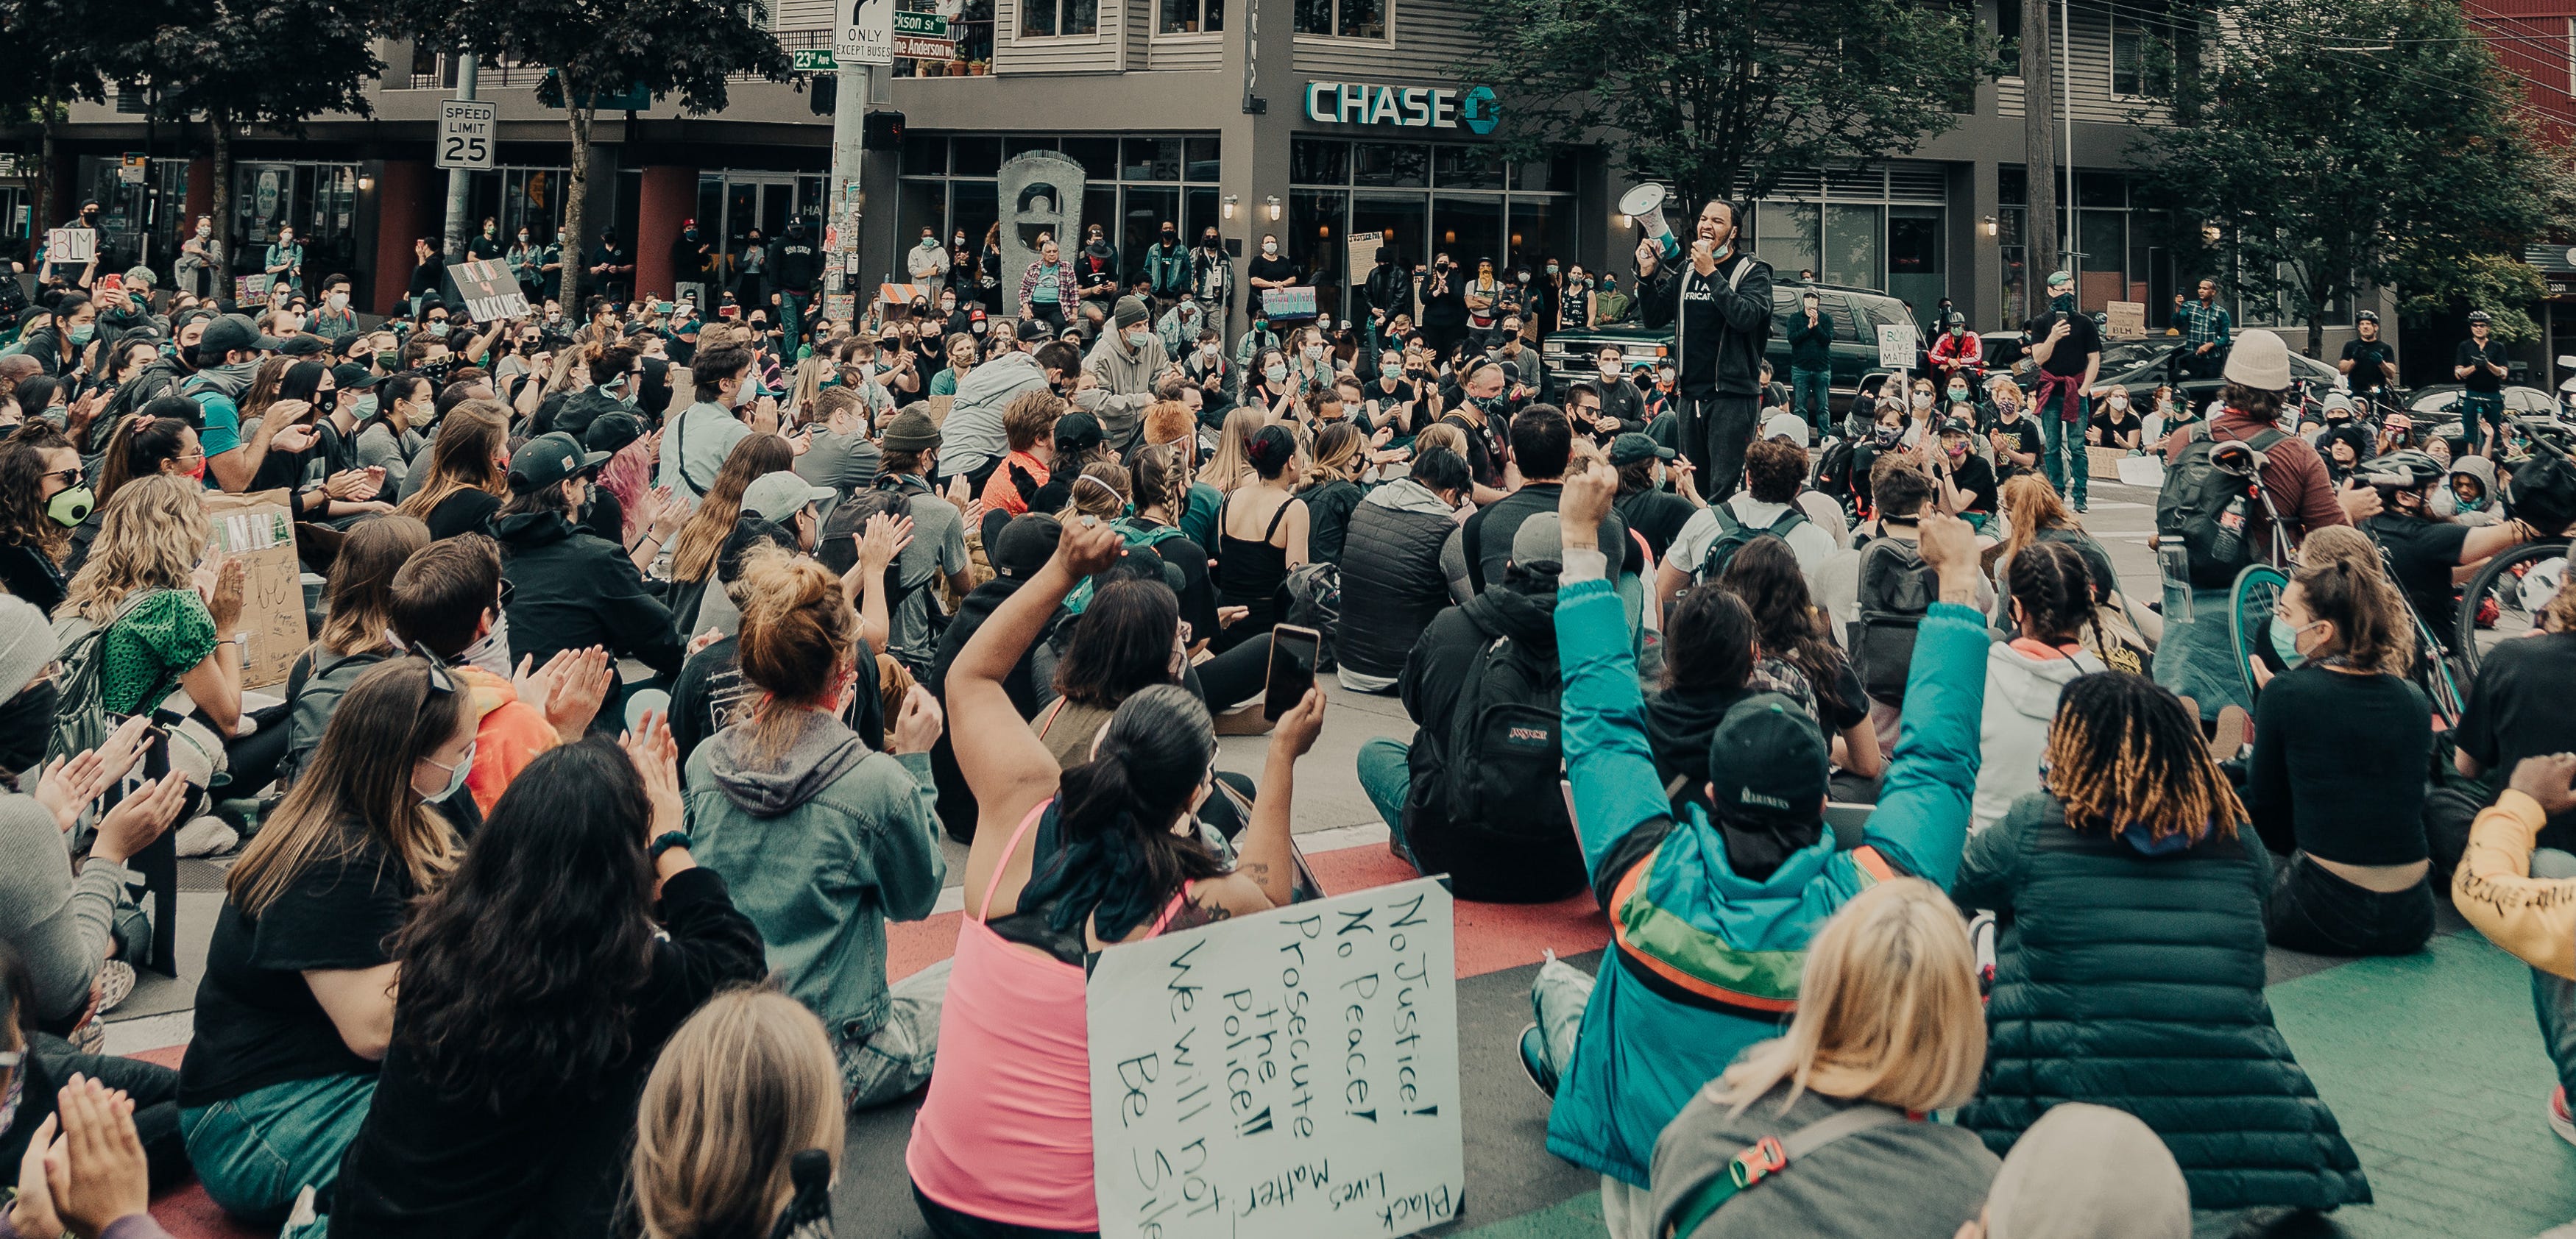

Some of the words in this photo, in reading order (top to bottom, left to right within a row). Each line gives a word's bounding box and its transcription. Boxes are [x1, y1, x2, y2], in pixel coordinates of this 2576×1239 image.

[849, 28, 882, 42] ONLY
[924, 19, 934, 30] St
[817, 54, 829, 65] Ave
[836, 44, 864, 55] EXCEPT
[867, 46, 891, 57] BUSES
[907, 39, 944, 57] Anderson
[945, 46, 954, 59] Wy
[446, 107, 491, 120] SPEED
[1306, 82, 1457, 128] CHASE
[450, 122, 485, 134] LIMIT
[445, 137, 486, 162] 25
[53, 230, 91, 260] BLM
[1348, 234, 1372, 242] JUSTICE
[479, 281, 495, 296] 4
[1694, 280, 1699, 291] I
[465, 297, 503, 323] BLACK
[495, 292, 533, 319] LIVES
[1886, 329, 1915, 342] BLACK
[2112, 327, 2132, 335] BLM
[2088, 447, 2120, 458] BLACK
[1336, 906, 1374, 959] No
[1387, 893, 1428, 952] No
[1167, 938, 1208, 1024] We
[1255, 1001, 1279, 1084] the
[1279, 915, 1323, 1140] Prosecute
[1393, 952, 1439, 1118] Justice!
[1338, 973, 1379, 1124] Peace!
[1173, 1026, 1212, 1123] will
[1117, 1051, 1160, 1129] Be
[1179, 1137, 1226, 1218] not
[1328, 1171, 1387, 1211] Lives
[1375, 1183, 1452, 1232] Black
